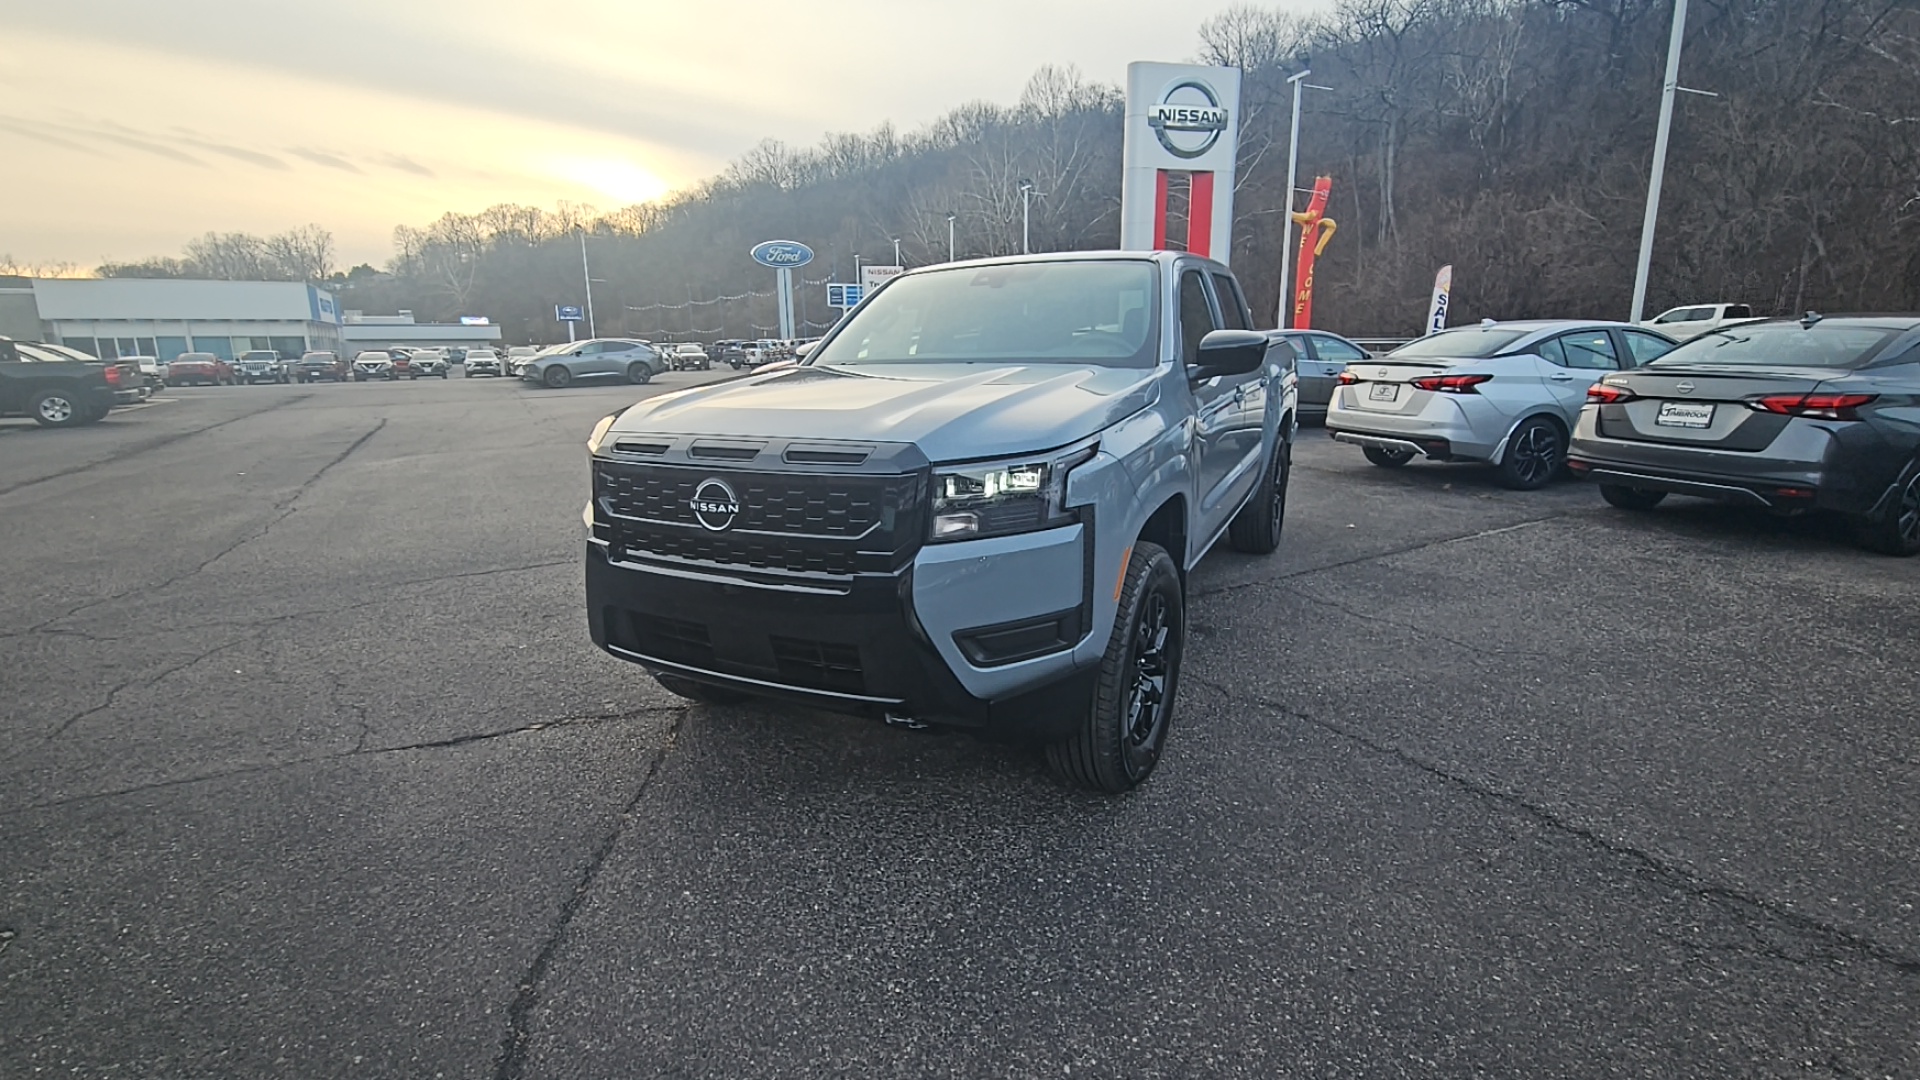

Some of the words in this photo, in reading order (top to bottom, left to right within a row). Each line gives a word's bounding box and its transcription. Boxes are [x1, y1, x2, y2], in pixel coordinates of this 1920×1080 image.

[1158, 108, 1222, 124] NISSAN
[766, 245, 801, 262] Ford
[867, 268, 901, 276] NISSAN
[1432, 294, 1448, 333] SAL
[690, 501, 739, 513] NISSAN
